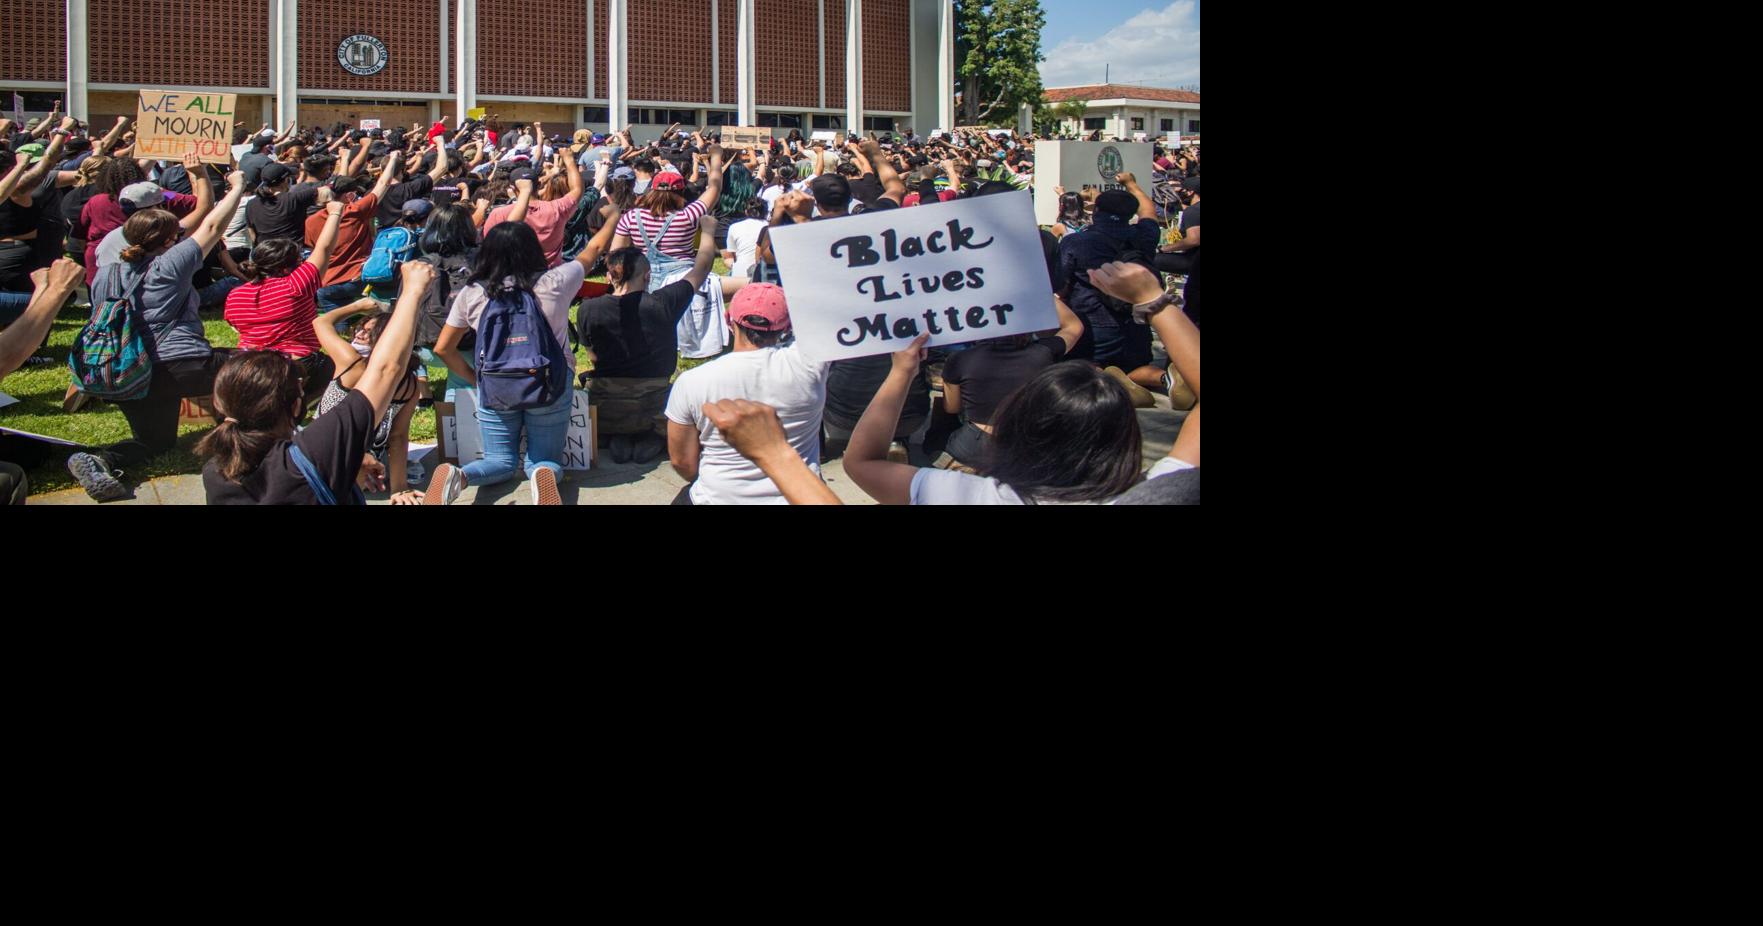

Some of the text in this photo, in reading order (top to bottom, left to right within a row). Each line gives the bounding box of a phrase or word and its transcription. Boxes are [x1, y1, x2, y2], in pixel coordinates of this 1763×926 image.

[338, 35, 387, 61] CITY OF FULLERTON
[344, 63, 381, 74] CALIFORNIA
[140, 94, 232, 115] WE ALL
[154, 116, 226, 140] MOURN
[138, 137, 228, 157] WITH YOU
[830, 218, 994, 268] Black
[856, 267, 984, 302] Lives
[836, 303, 1014, 346] Matter
